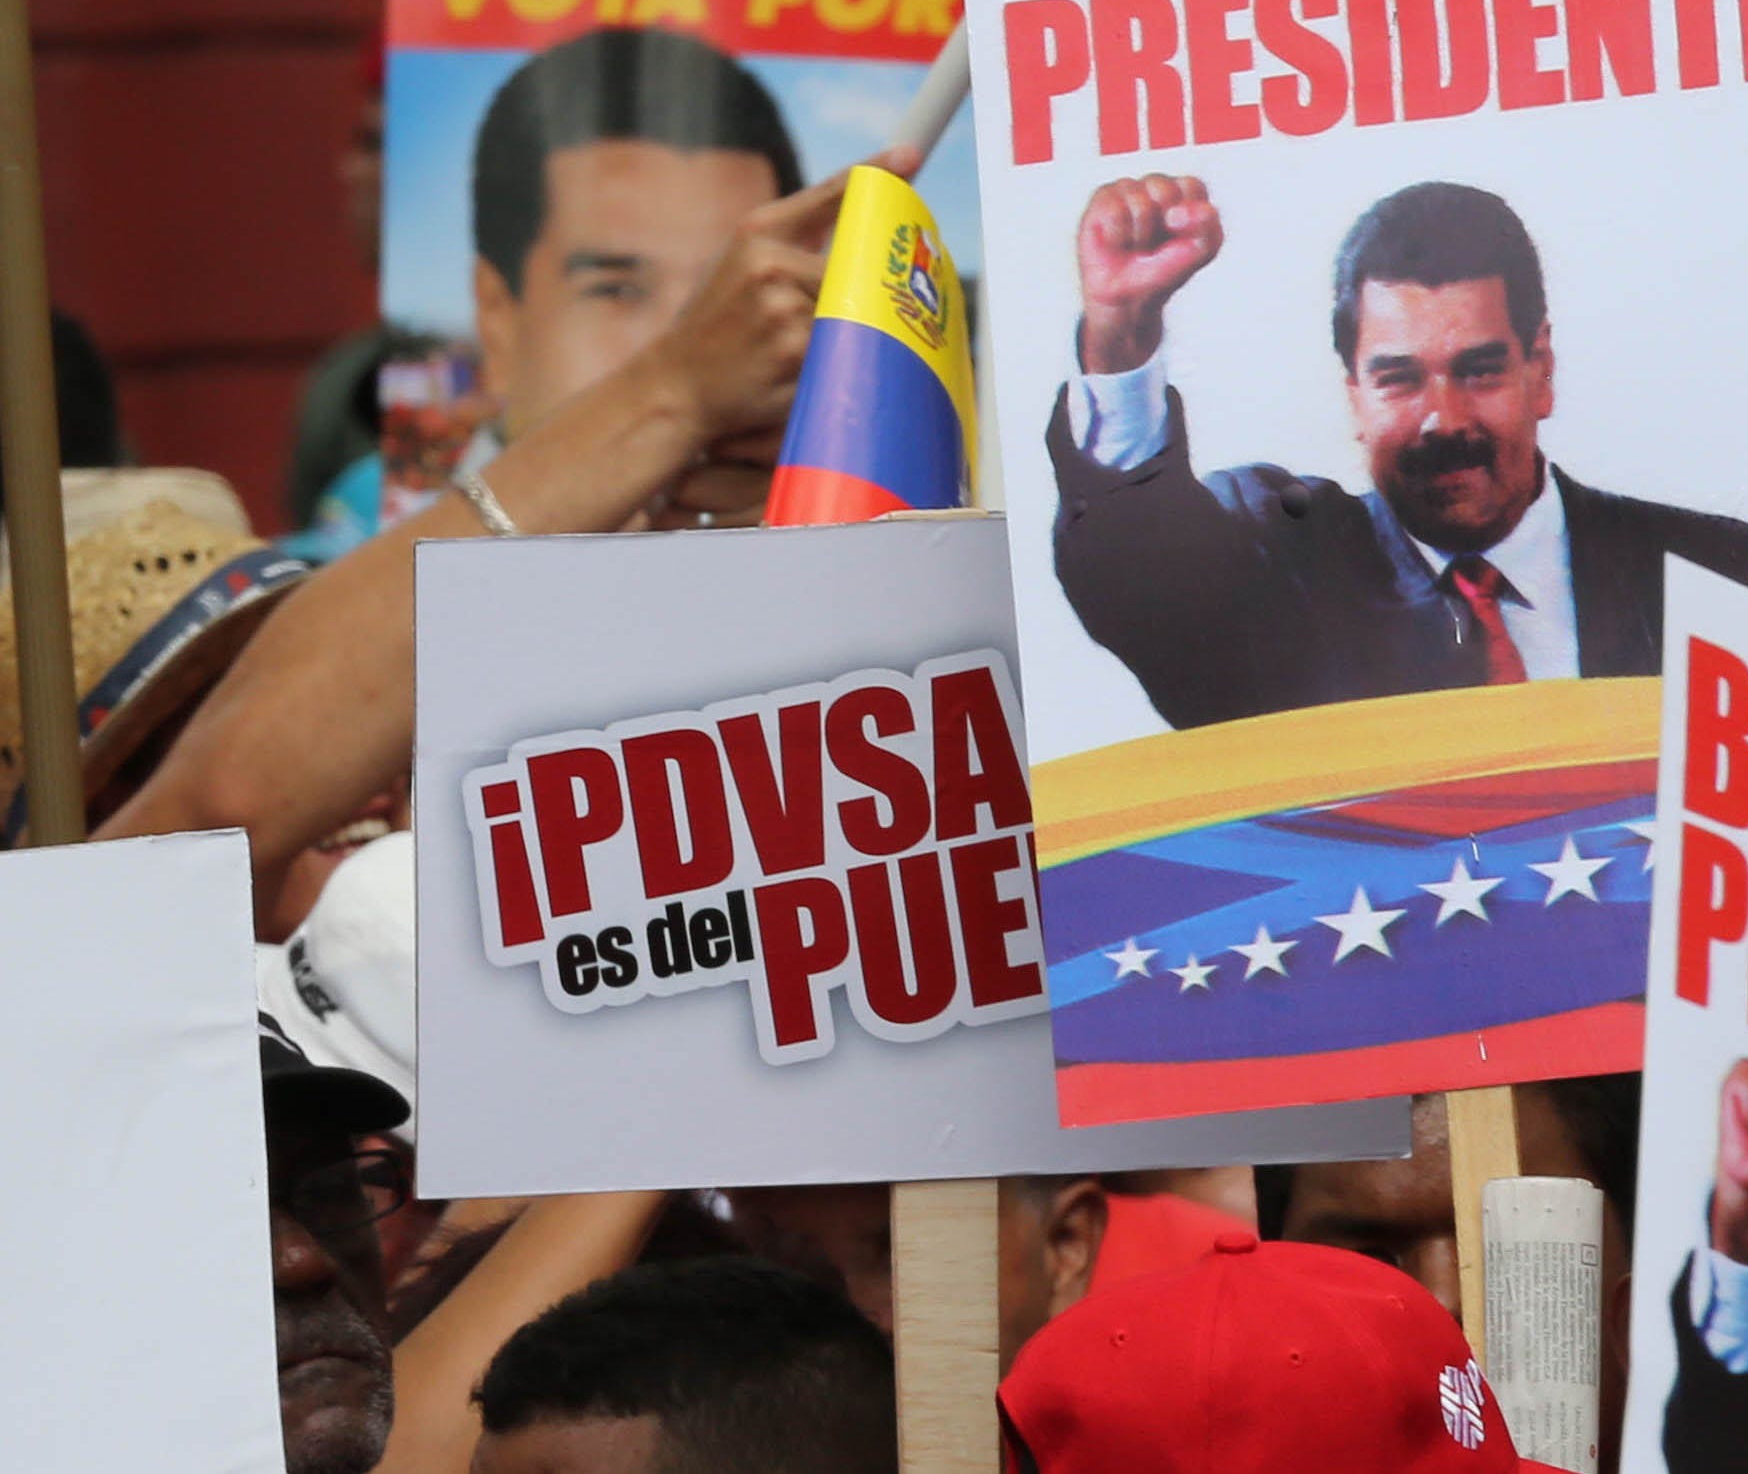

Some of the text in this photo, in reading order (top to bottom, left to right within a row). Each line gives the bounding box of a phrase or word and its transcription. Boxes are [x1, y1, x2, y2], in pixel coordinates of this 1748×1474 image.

[556, 889, 755, 996] es del
[755, 838, 1043, 1045] PUE
